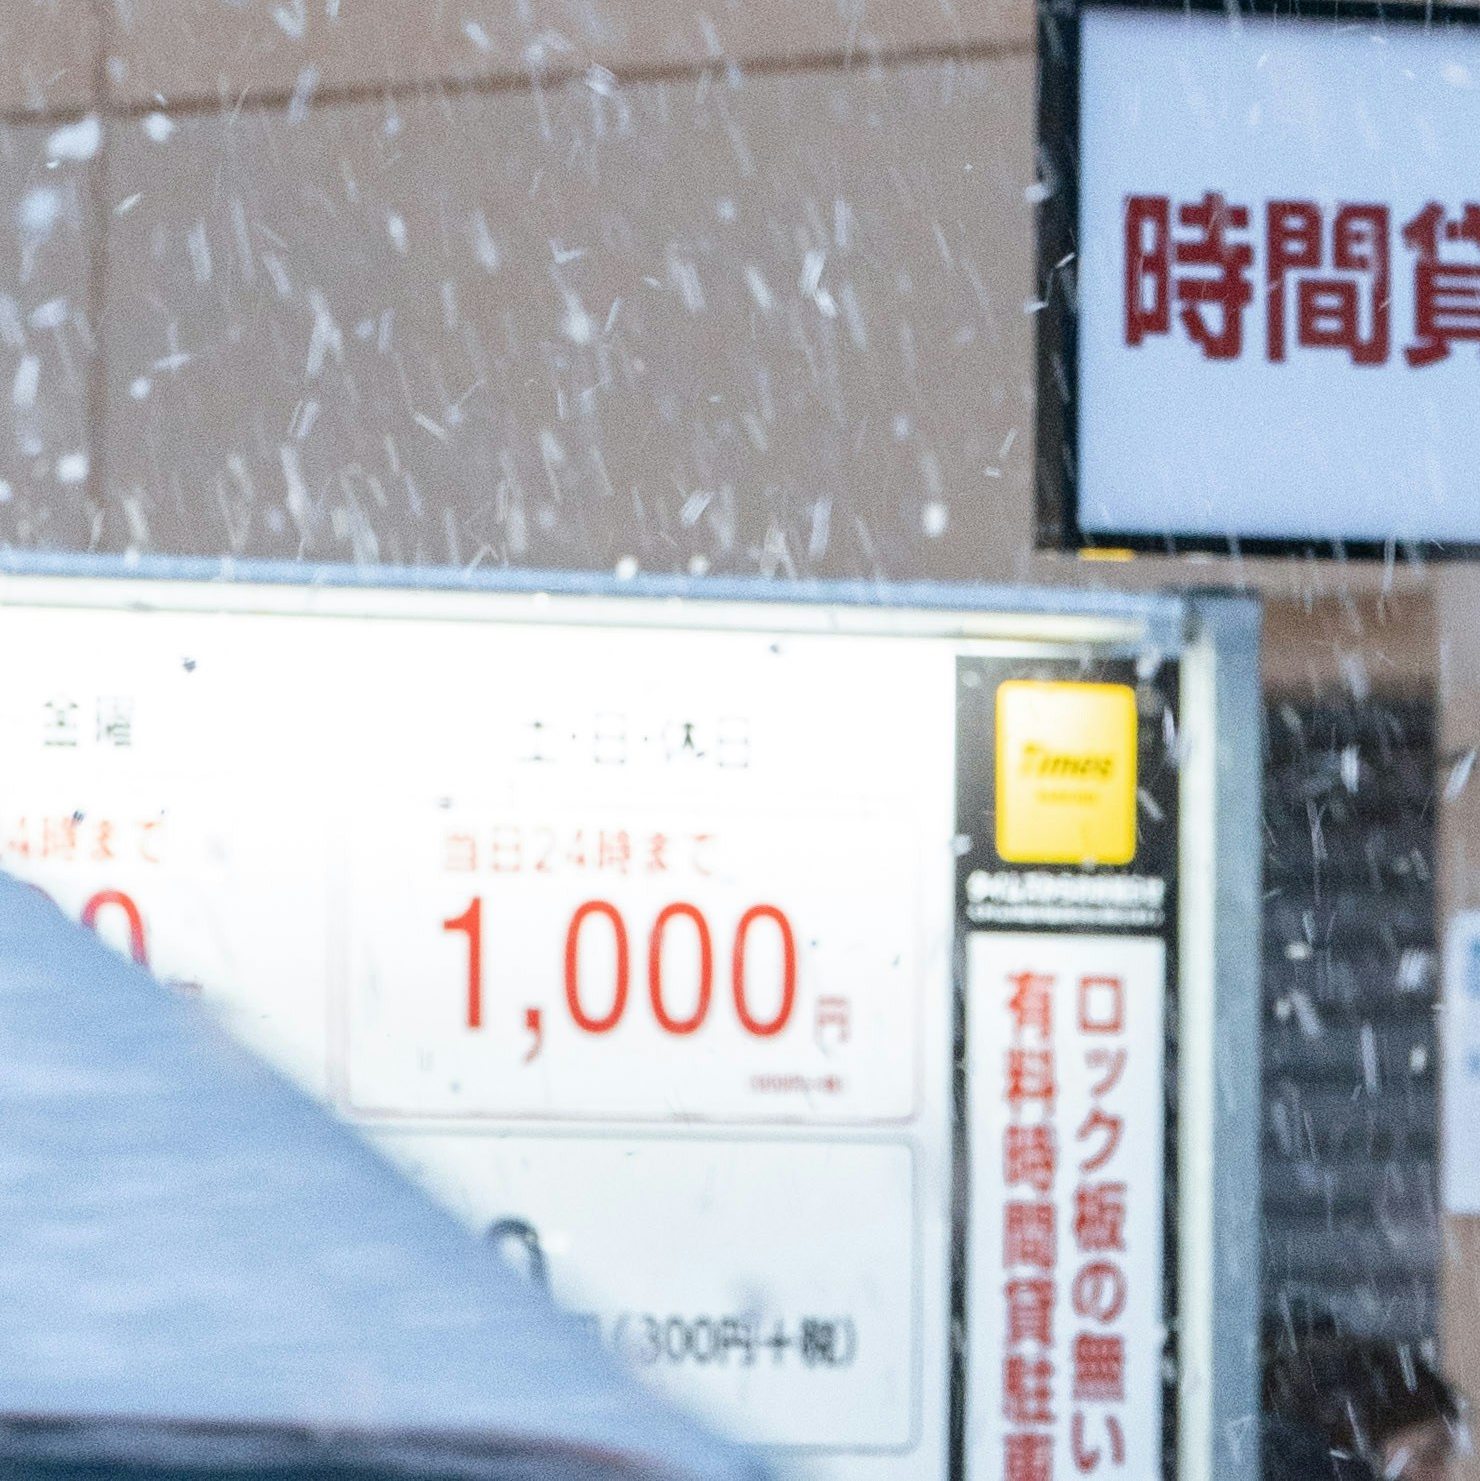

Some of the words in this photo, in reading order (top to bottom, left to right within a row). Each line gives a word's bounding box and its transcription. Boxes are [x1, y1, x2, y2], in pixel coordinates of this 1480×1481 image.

[1073, 973, 1127, 1474] ロック板の無い
